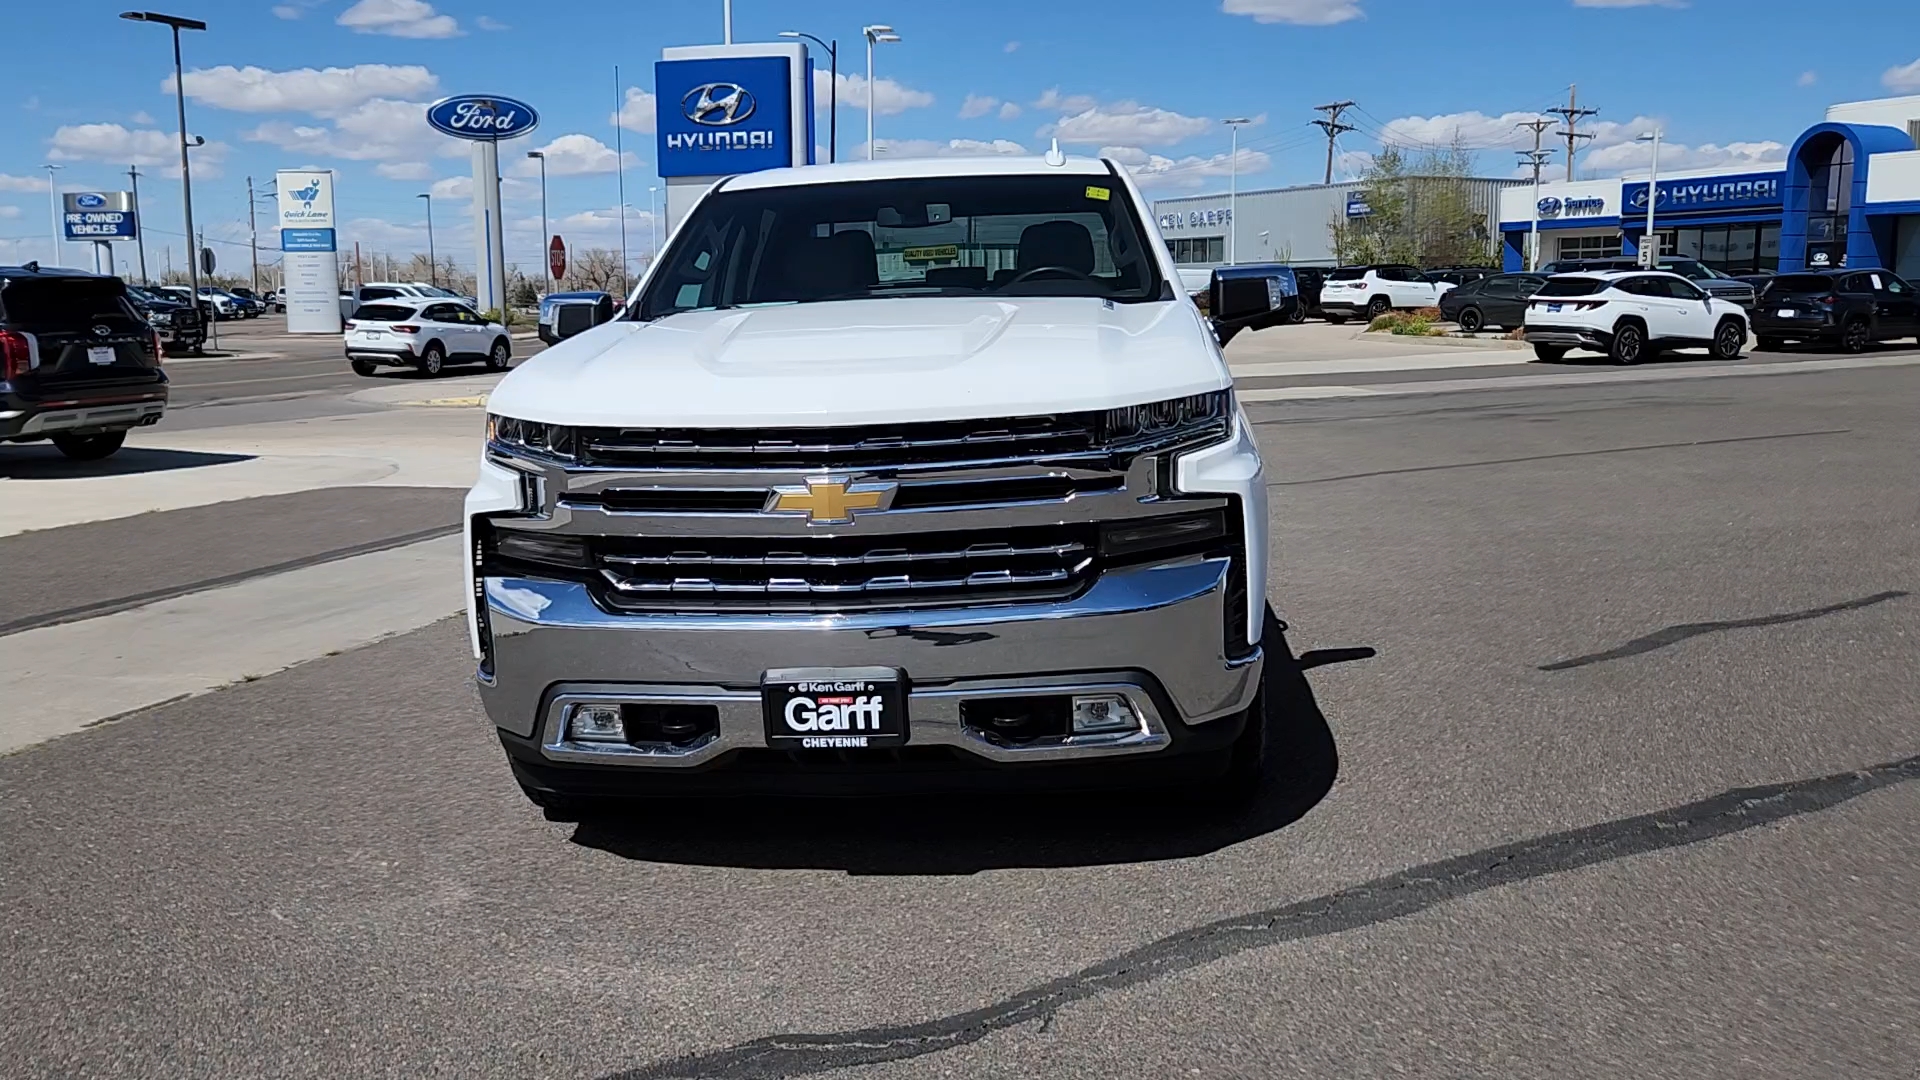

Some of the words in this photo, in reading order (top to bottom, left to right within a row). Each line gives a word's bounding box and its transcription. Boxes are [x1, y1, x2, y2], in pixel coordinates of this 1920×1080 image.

[450, 102, 515, 129] Ford
[667, 130, 773, 151] HYUNDAI
[1671, 179, 1777, 205] HYUNDAI
[80, 195, 99, 206] Ford
[1564, 195, 1605, 211] Service
[66, 212, 124, 224] PRE-OWNED
[284, 210, 306, 218] Quick
[307, 210, 328, 218] Lane
[1160, 212, 1184, 228] KEN
[71, 224, 118, 235] VEHICLES
[551, 250, 565, 267] STOP
[1642, 251, 1648, 262] 5
[809, 682, 834, 692] Ken
[834, 681, 865, 692] Garff
[785, 695, 884, 732] Garff
[802, 737, 869, 748] CHEYENNE
